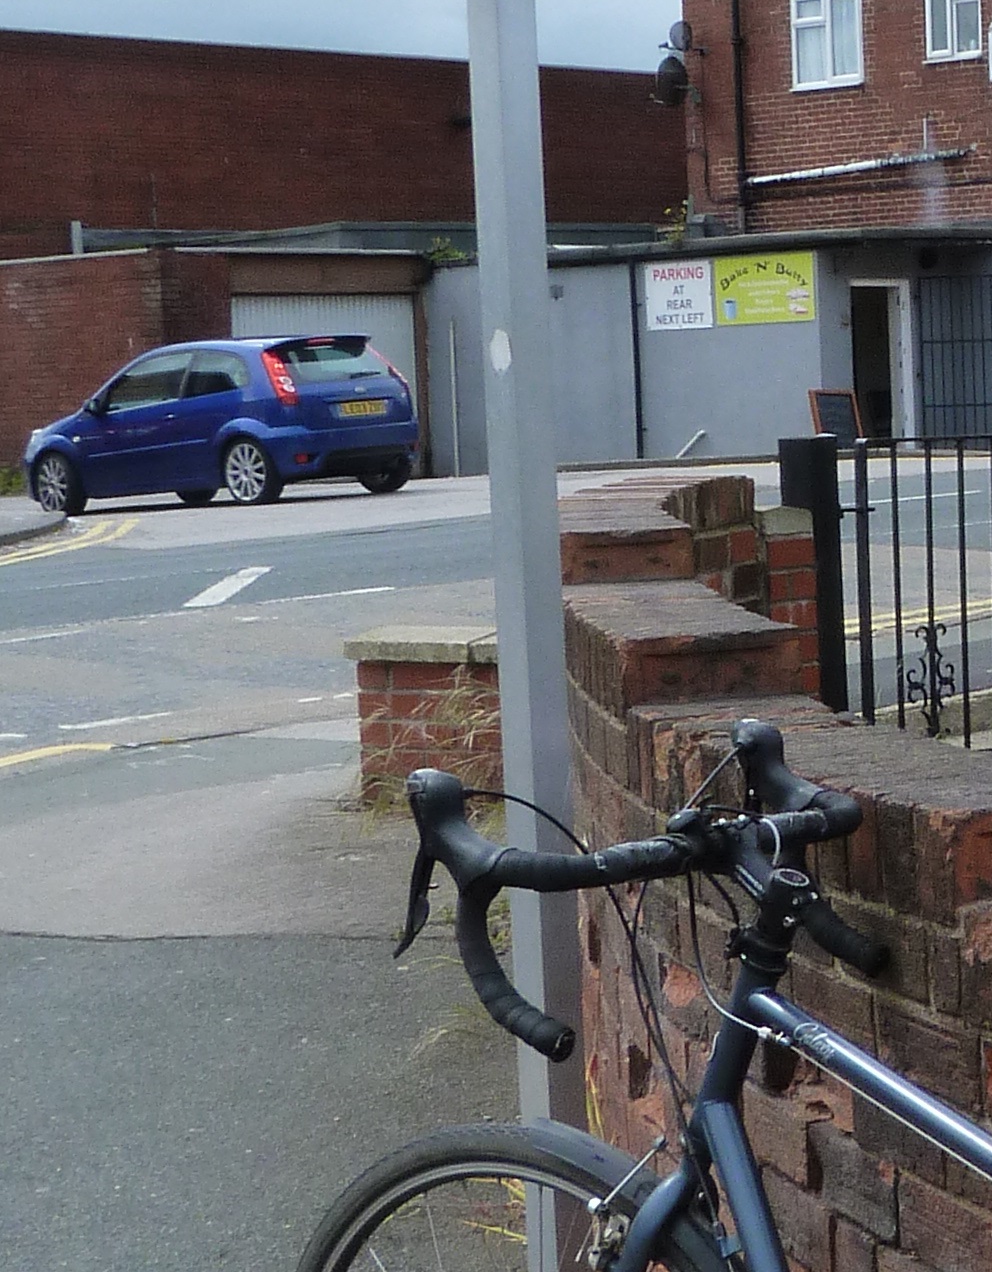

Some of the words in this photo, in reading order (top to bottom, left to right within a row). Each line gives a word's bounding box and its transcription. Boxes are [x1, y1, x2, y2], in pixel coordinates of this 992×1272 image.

[653, 266, 704, 281] PARKING
[673, 285, 684, 295] AT
[666, 299, 693, 310] REAR
[656, 314, 681, 325] NEXT
[682, 313, 704, 324] LEFT
